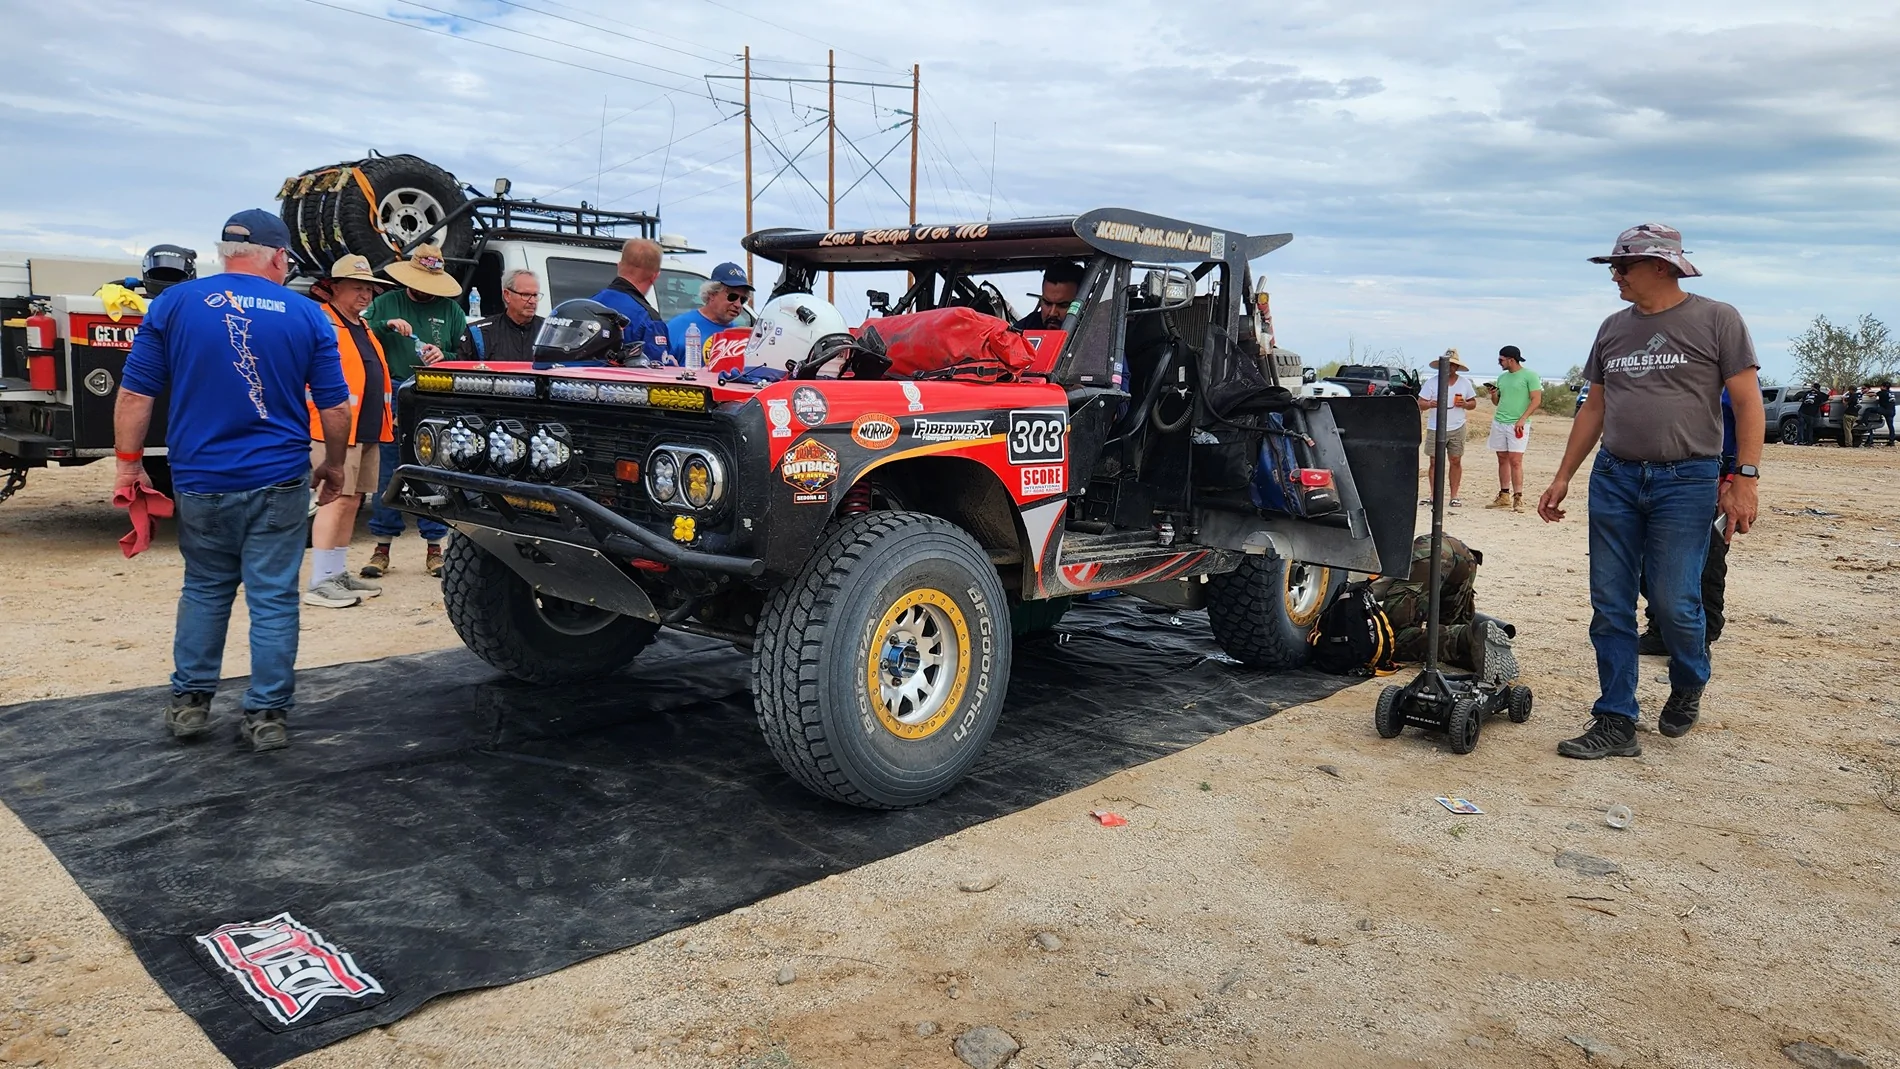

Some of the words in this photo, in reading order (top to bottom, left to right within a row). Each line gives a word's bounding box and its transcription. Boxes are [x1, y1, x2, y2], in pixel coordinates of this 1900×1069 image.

[819, 232, 856, 246] Love
[862, 228, 910, 246] Reign
[955, 224, 989, 240] Me
[256, 298, 286, 313] RACING
[94, 325, 121, 342] GET
[124, 326, 139, 343] O
[1012, 420, 1062, 454] 303
[783, 460, 838, 476] OUTBACK
[1024, 468, 1061, 486] SCORE
[953, 586, 992, 742] BFGoodrich
